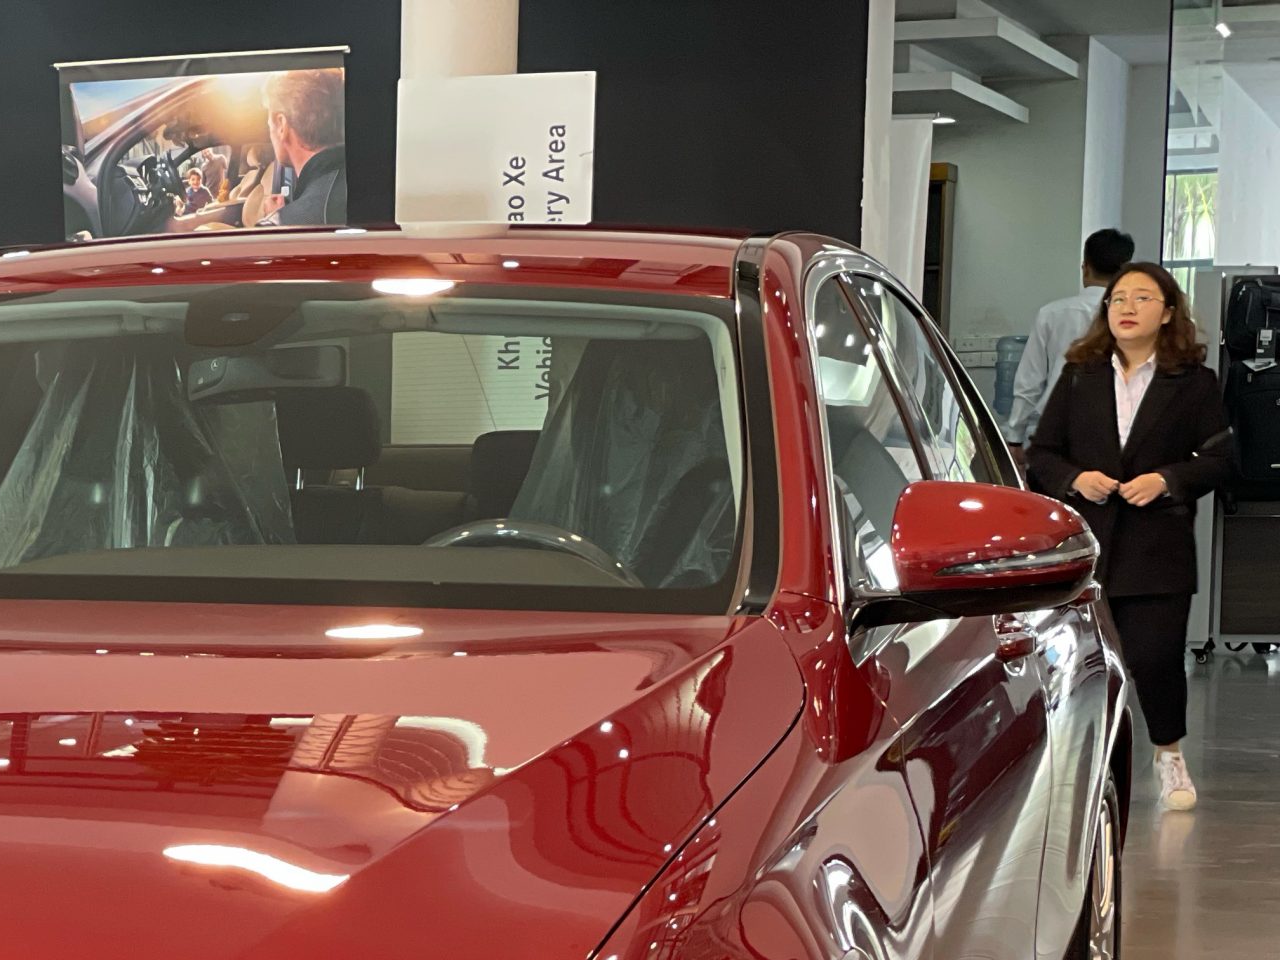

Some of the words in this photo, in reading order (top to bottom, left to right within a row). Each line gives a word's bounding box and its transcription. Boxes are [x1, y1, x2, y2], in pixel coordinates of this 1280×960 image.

[542, 124, 566, 182] Area
[502, 156, 526, 187] Xe
[507, 195, 525, 222] ao
[546, 191, 570, 222] ry
[497, 335, 520, 370] Kh
[535, 336, 553, 400] Vehic
